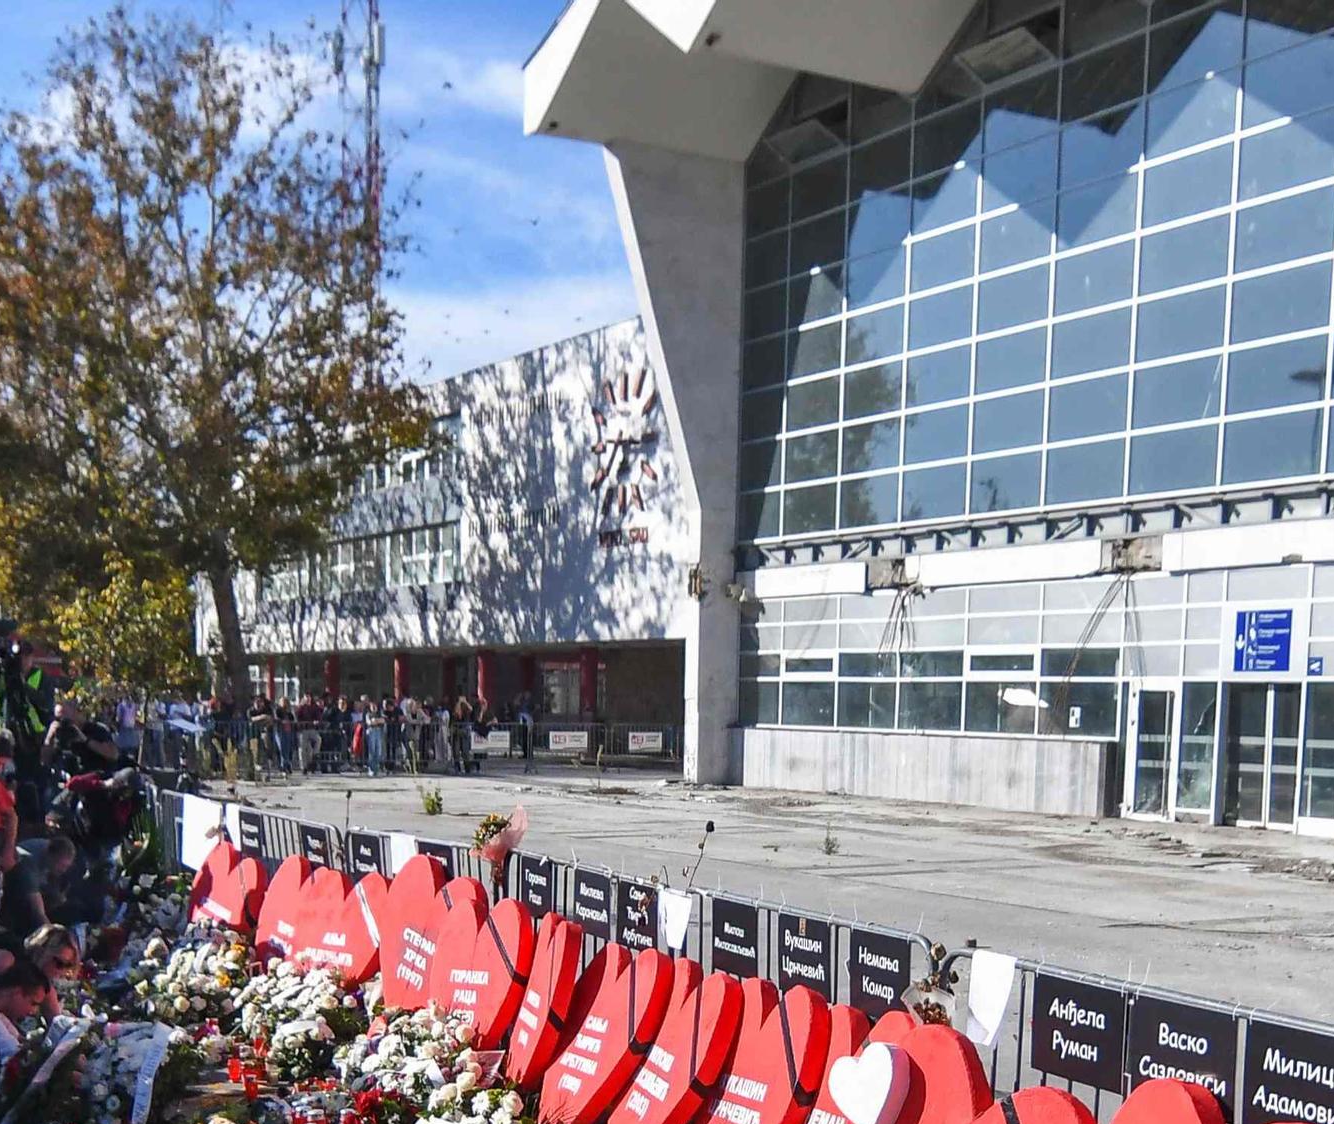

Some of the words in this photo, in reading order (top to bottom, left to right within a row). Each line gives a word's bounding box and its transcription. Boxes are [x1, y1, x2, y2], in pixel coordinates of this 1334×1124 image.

[784, 929, 823, 955] Вукашин
[782, 955, 826, 983] Црнчевић
[858, 946, 900, 974] Немања
[862, 976, 895, 1005] Комар
[1048, 997, 1106, 1031] Анђела
[1052, 1030, 1099, 1063] Руман
[1158, 1022, 1209, 1056] Васко
